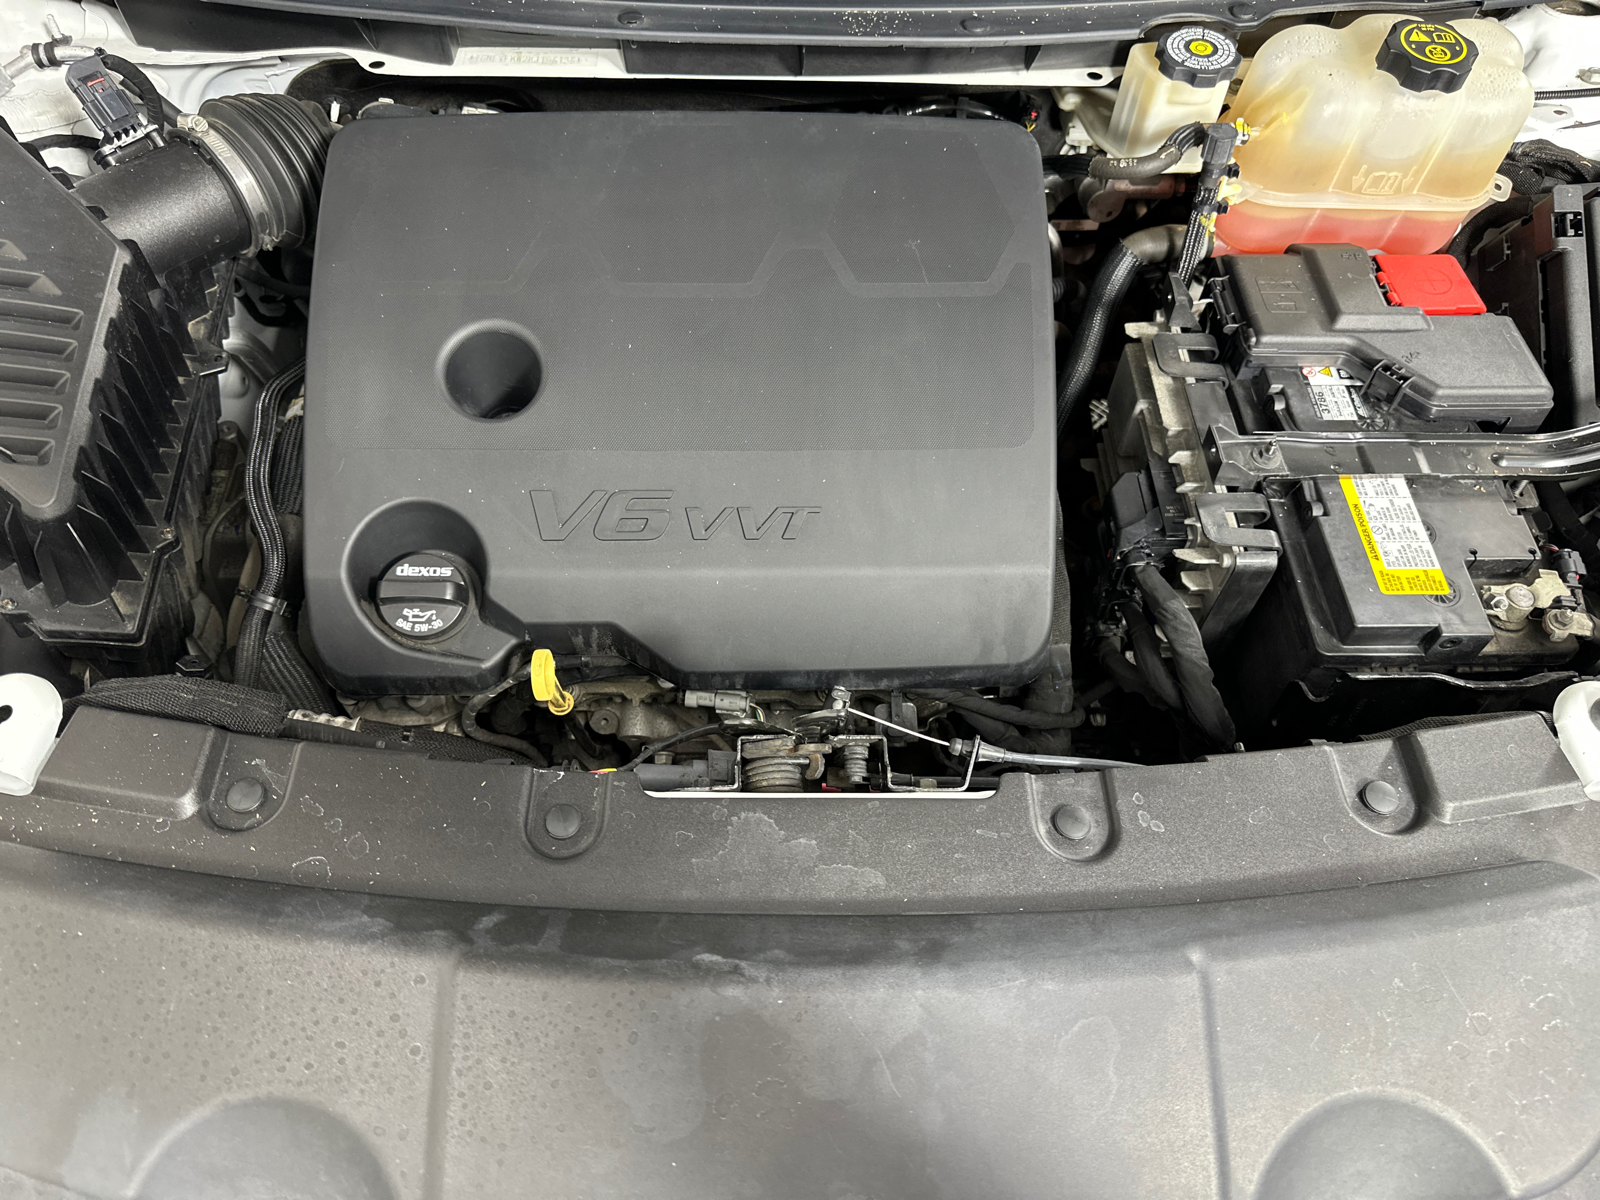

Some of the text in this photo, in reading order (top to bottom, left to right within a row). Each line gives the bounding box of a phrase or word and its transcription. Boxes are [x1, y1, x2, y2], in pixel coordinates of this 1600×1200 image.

[1315, 391, 1331, 414] 3786
[529, 490, 822, 541] V6 VVT
[1351, 503, 1377, 555] DANGER POISON
[395, 563, 454, 577] dexos
[395, 618, 444, 632] SAE 5W-30
